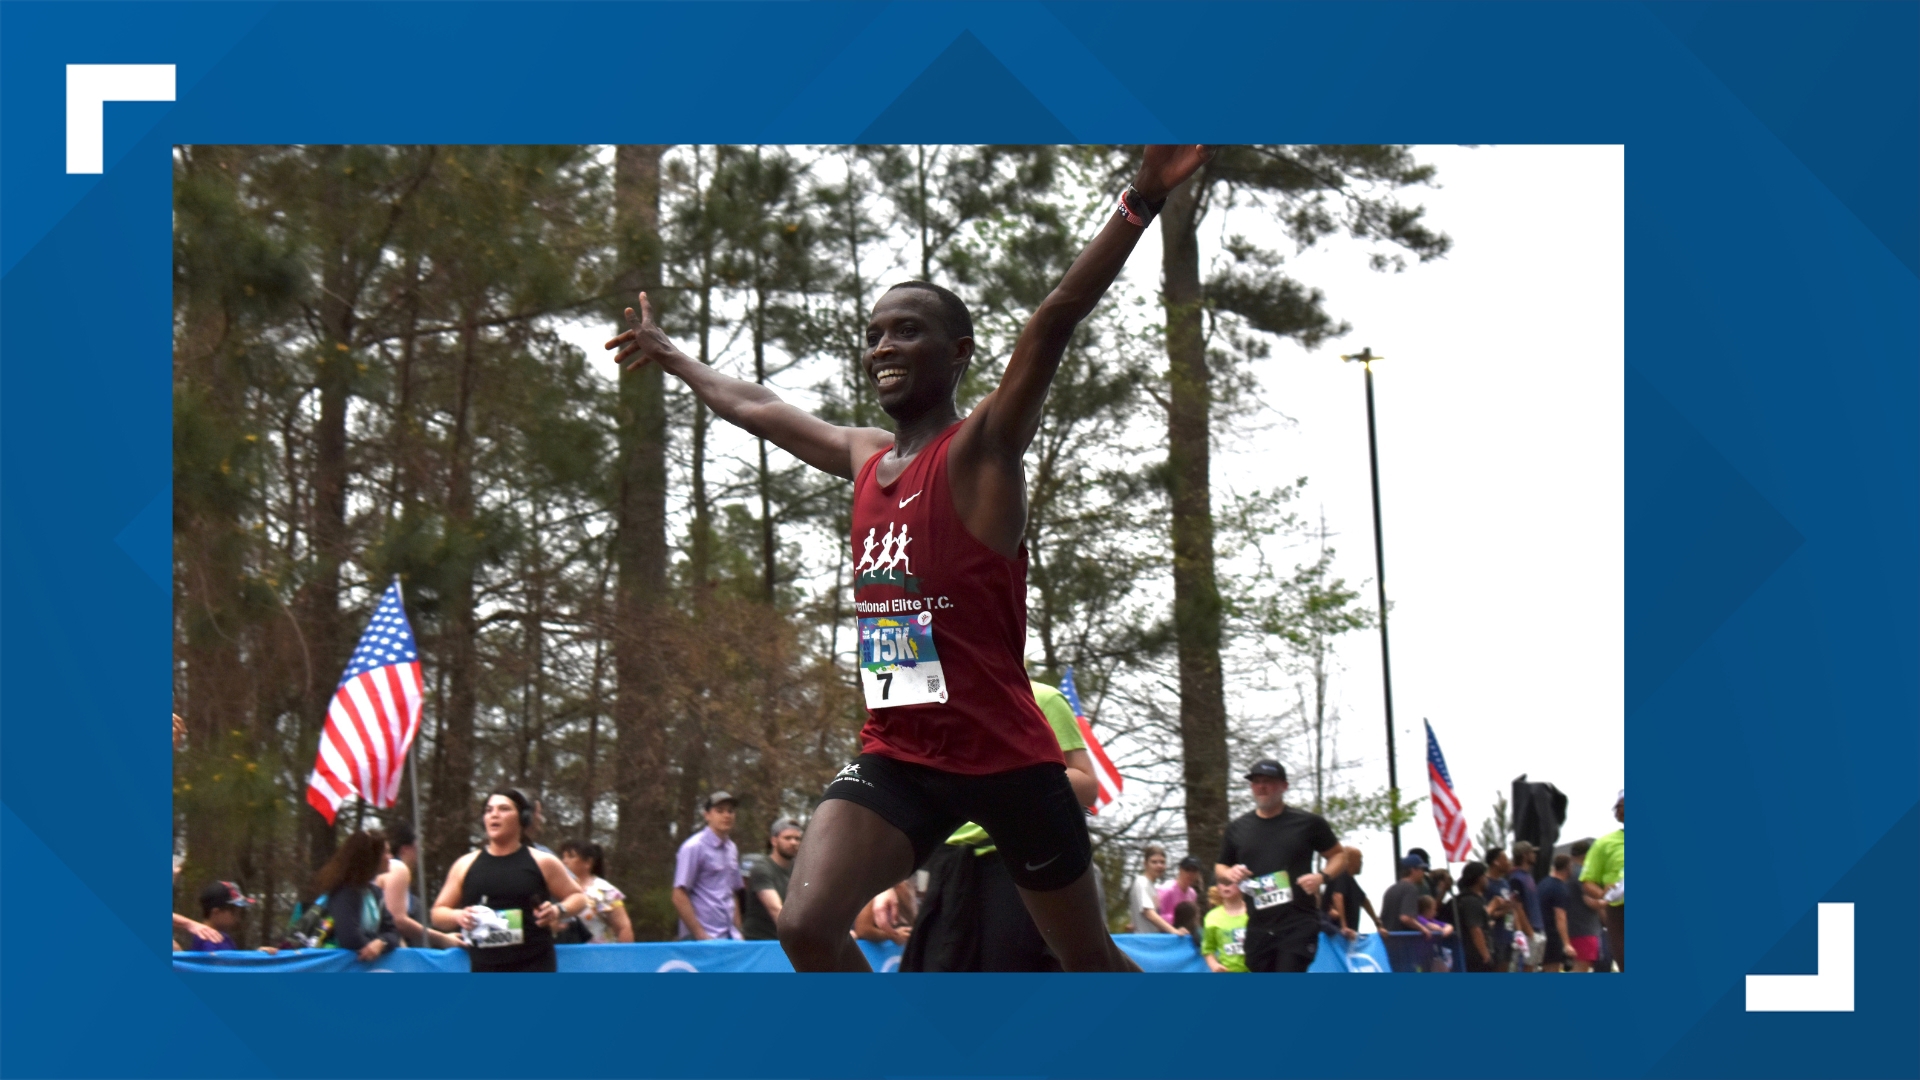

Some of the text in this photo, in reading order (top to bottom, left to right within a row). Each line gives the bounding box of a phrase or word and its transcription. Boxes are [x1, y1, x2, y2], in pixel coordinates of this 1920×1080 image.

[892, 598, 921, 611] Elite
[923, 596, 953, 610] T.C.
[871, 627, 914, 662] 15K
[877, 673, 893, 700] 7
